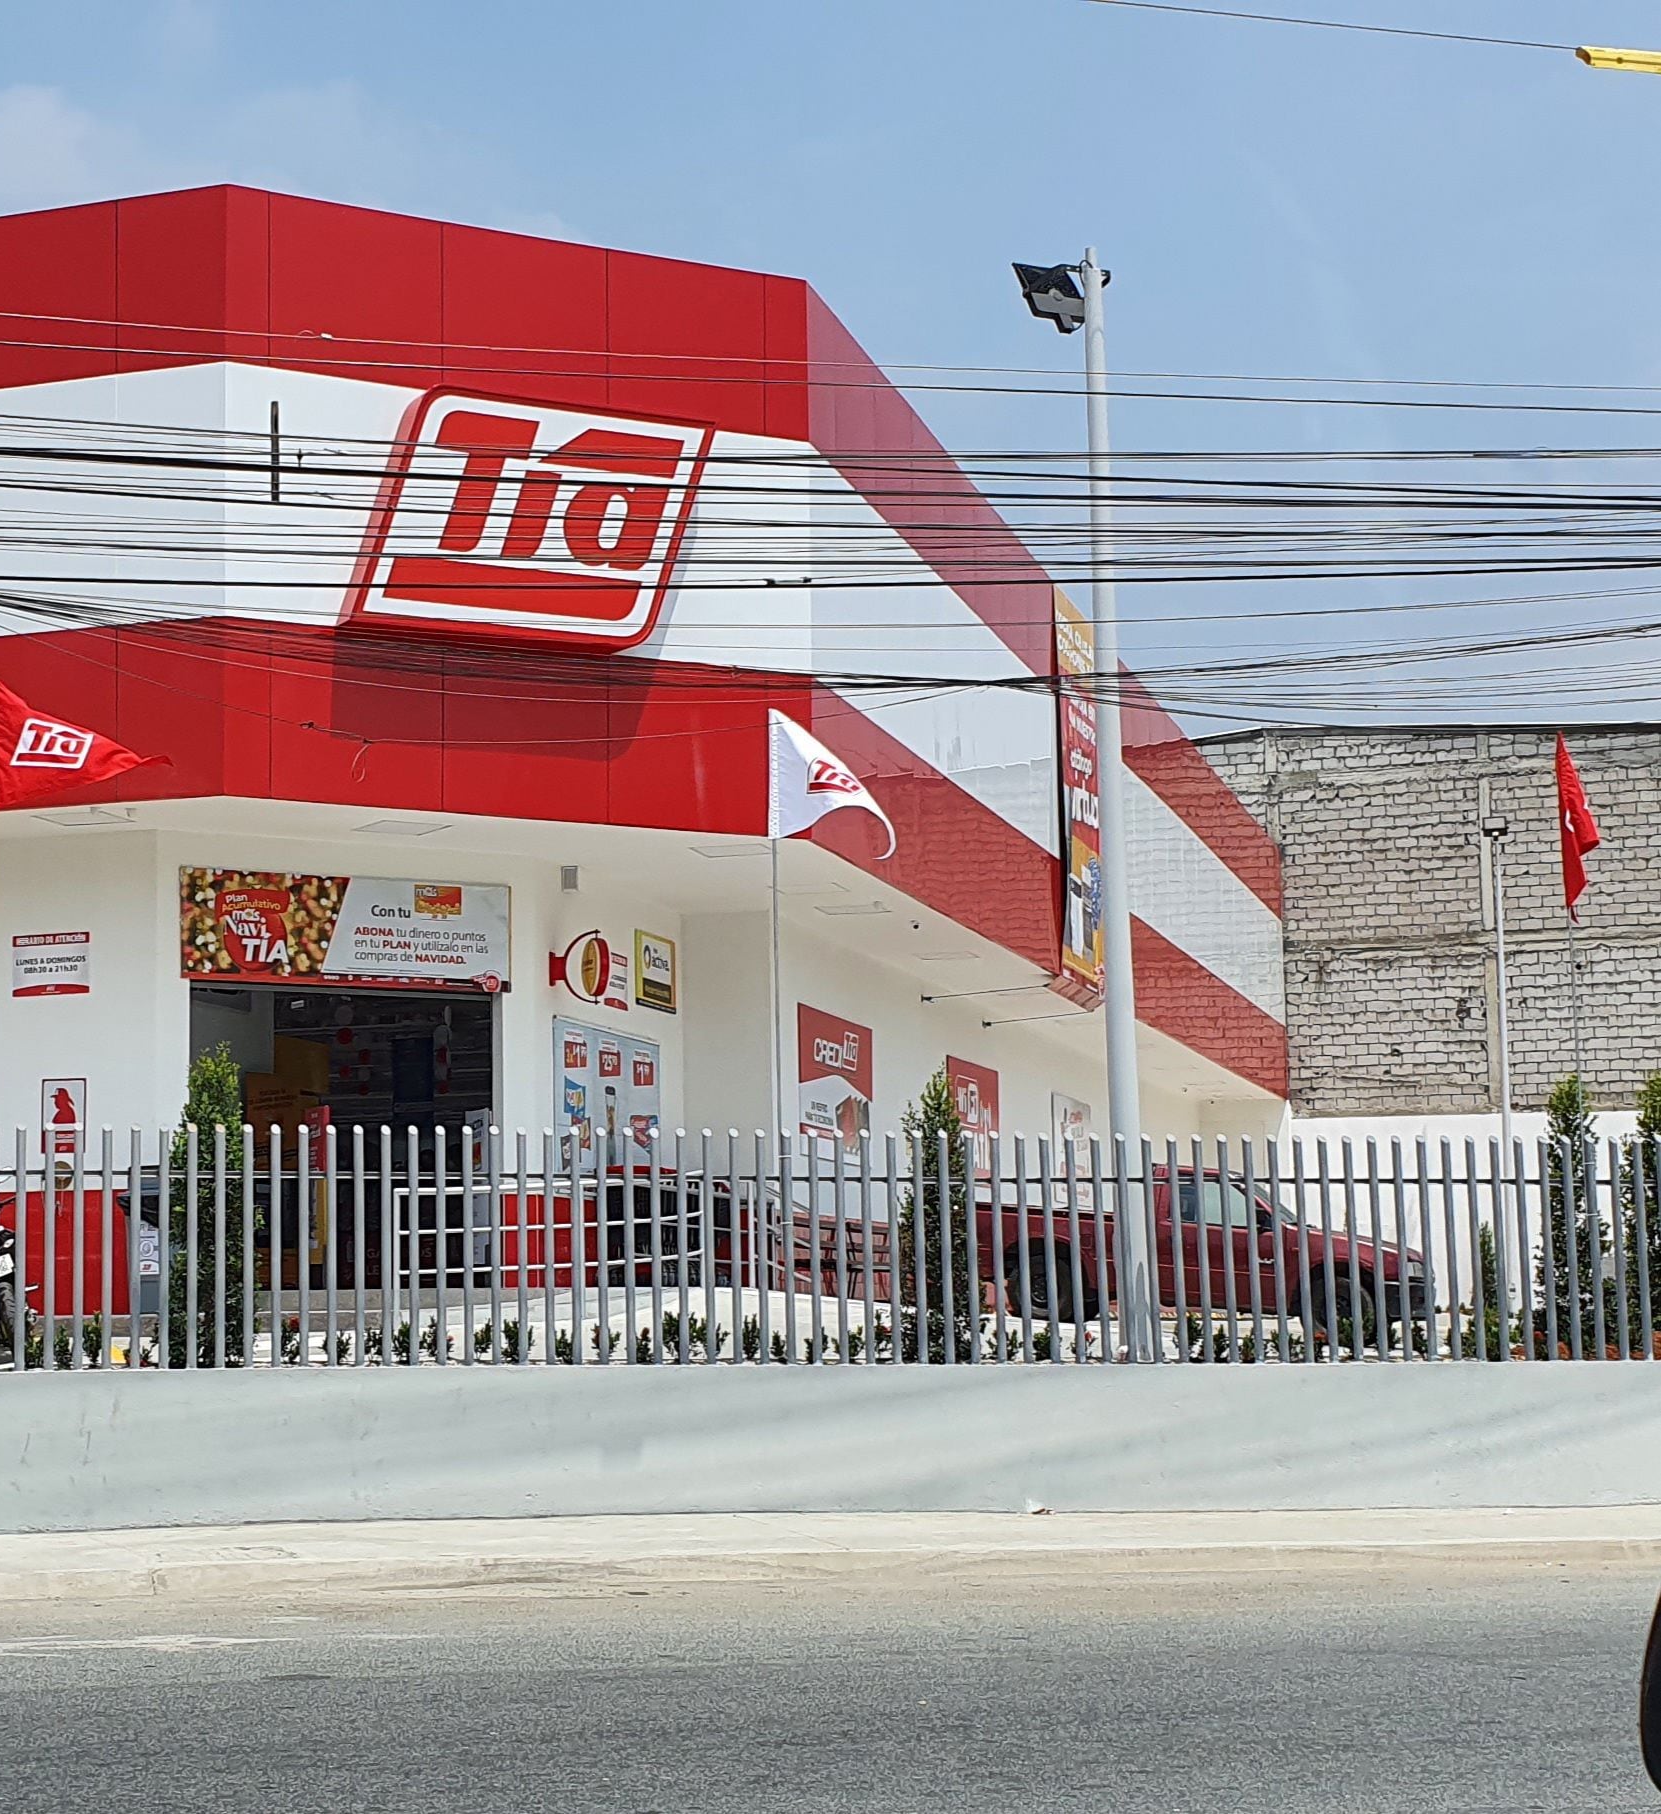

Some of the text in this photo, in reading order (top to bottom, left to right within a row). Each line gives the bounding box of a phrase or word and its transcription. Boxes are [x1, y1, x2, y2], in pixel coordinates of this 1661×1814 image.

[371, 904, 395, 918] Con
[398, 906, 411, 919] tu
[354, 926, 487, 944] ABONA tu dinero o puntos
[354, 940, 368, 949] en
[369, 938, 381, 949] tu
[382, 940, 411, 950] PLAN
[413, 943, 419, 953] y
[461, 945, 473, 954] en
[475, 943, 489, 954] las
[16, 958, 39, 967] LUNES
[46, 955, 87, 965] DOMINGOS
[354, 951, 467, 965] compras de NAVIDAD.
